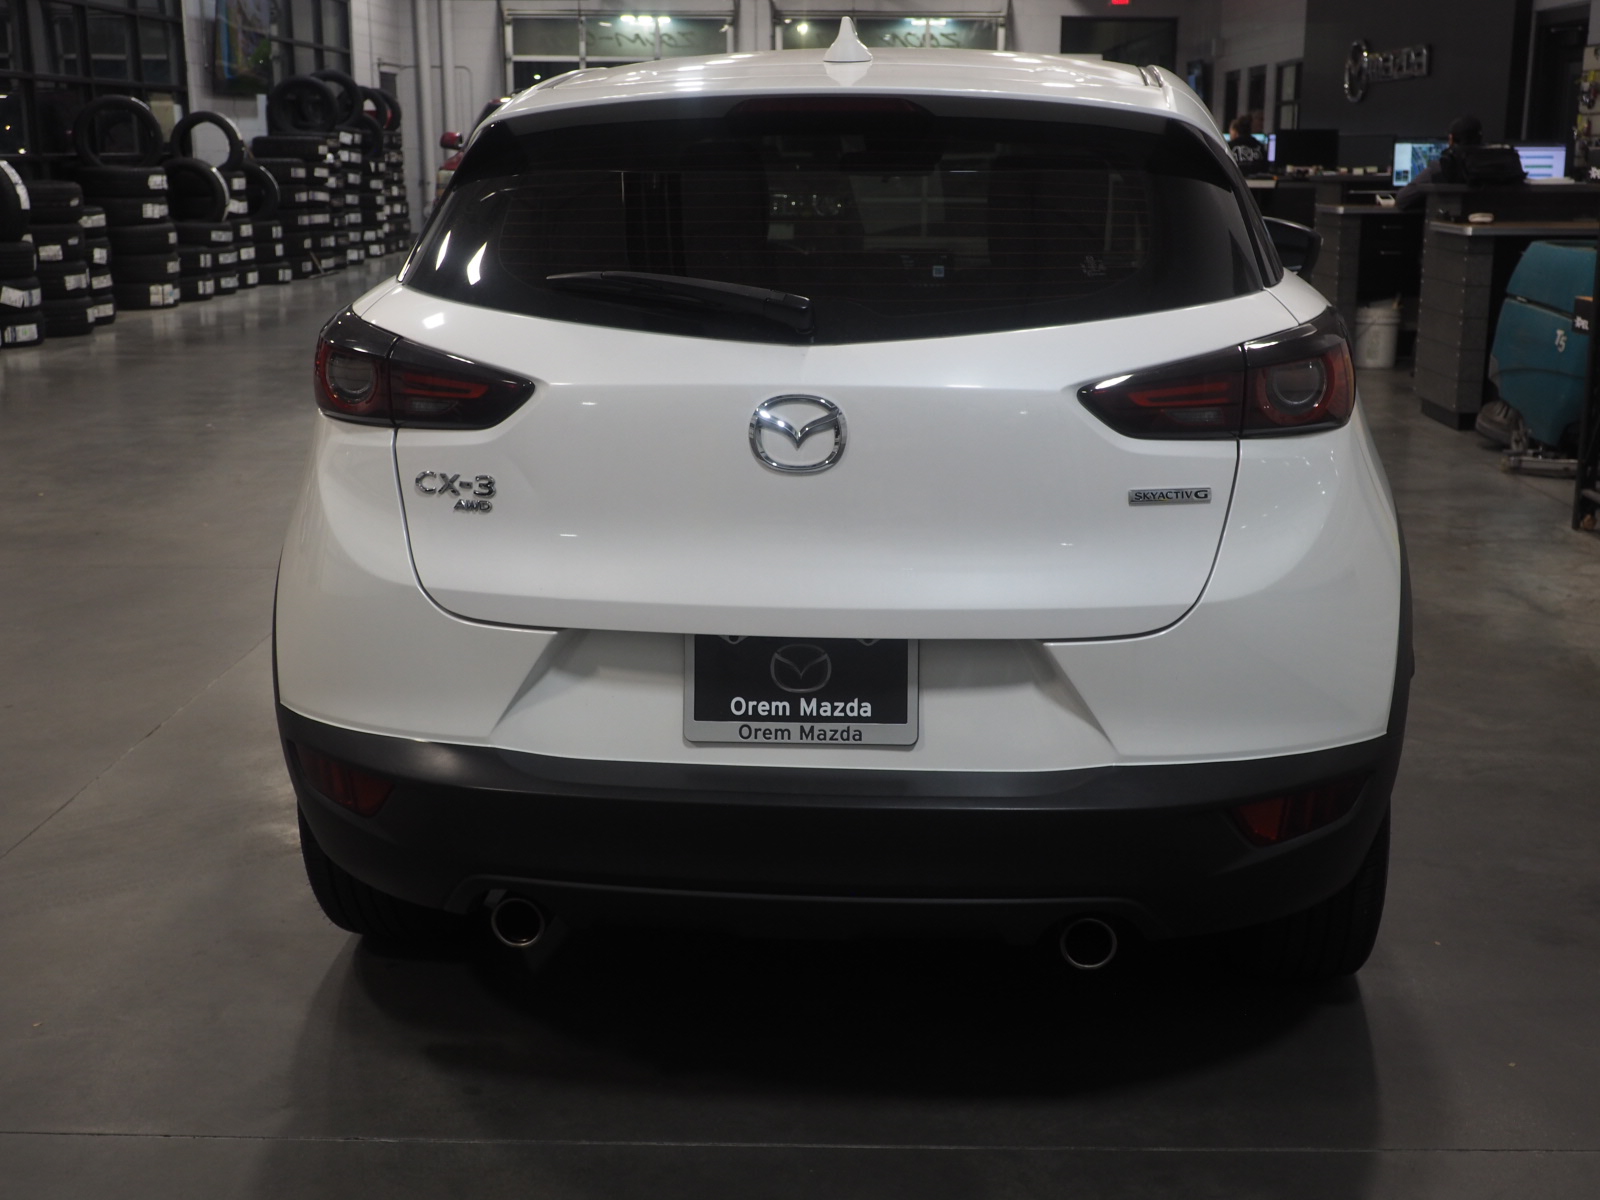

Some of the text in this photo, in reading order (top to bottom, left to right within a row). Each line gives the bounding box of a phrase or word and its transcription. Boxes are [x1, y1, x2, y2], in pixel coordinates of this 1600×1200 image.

[415, 470, 497, 499] CX-3
[453, 499, 493, 513] AWD
[730, 696, 872, 718] Orem Mazda
[738, 723, 863, 742] Orem Mazda
